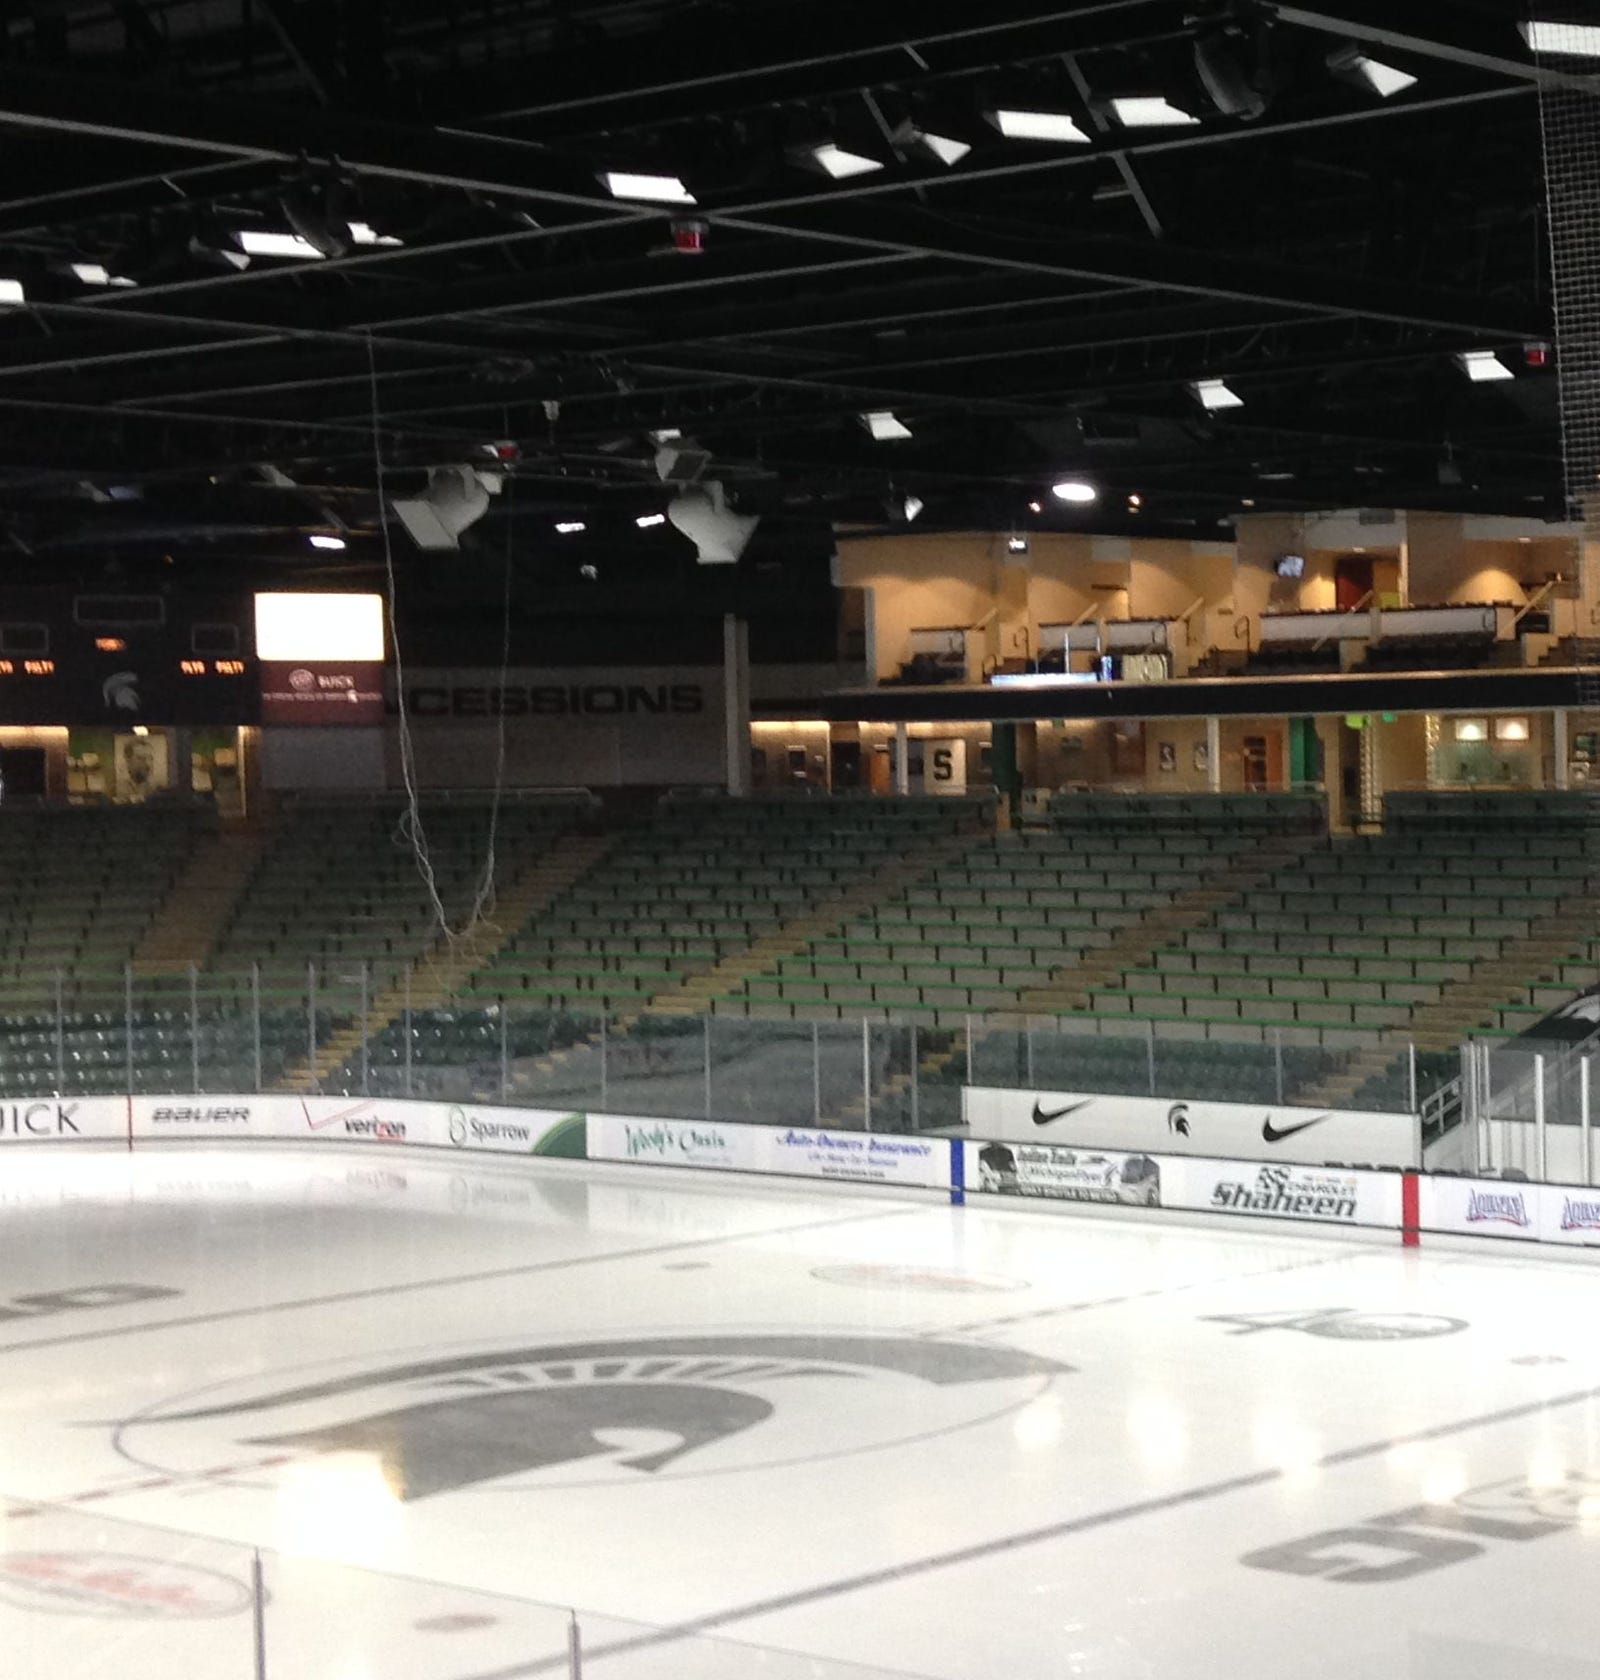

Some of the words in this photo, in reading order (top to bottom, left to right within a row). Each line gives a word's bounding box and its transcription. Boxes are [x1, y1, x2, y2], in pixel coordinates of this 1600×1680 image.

[0, 1103, 80, 1135] ICK
[470, 1118, 529, 1142] Sparrow
[1211, 1181, 1357, 1217] Shaheen
